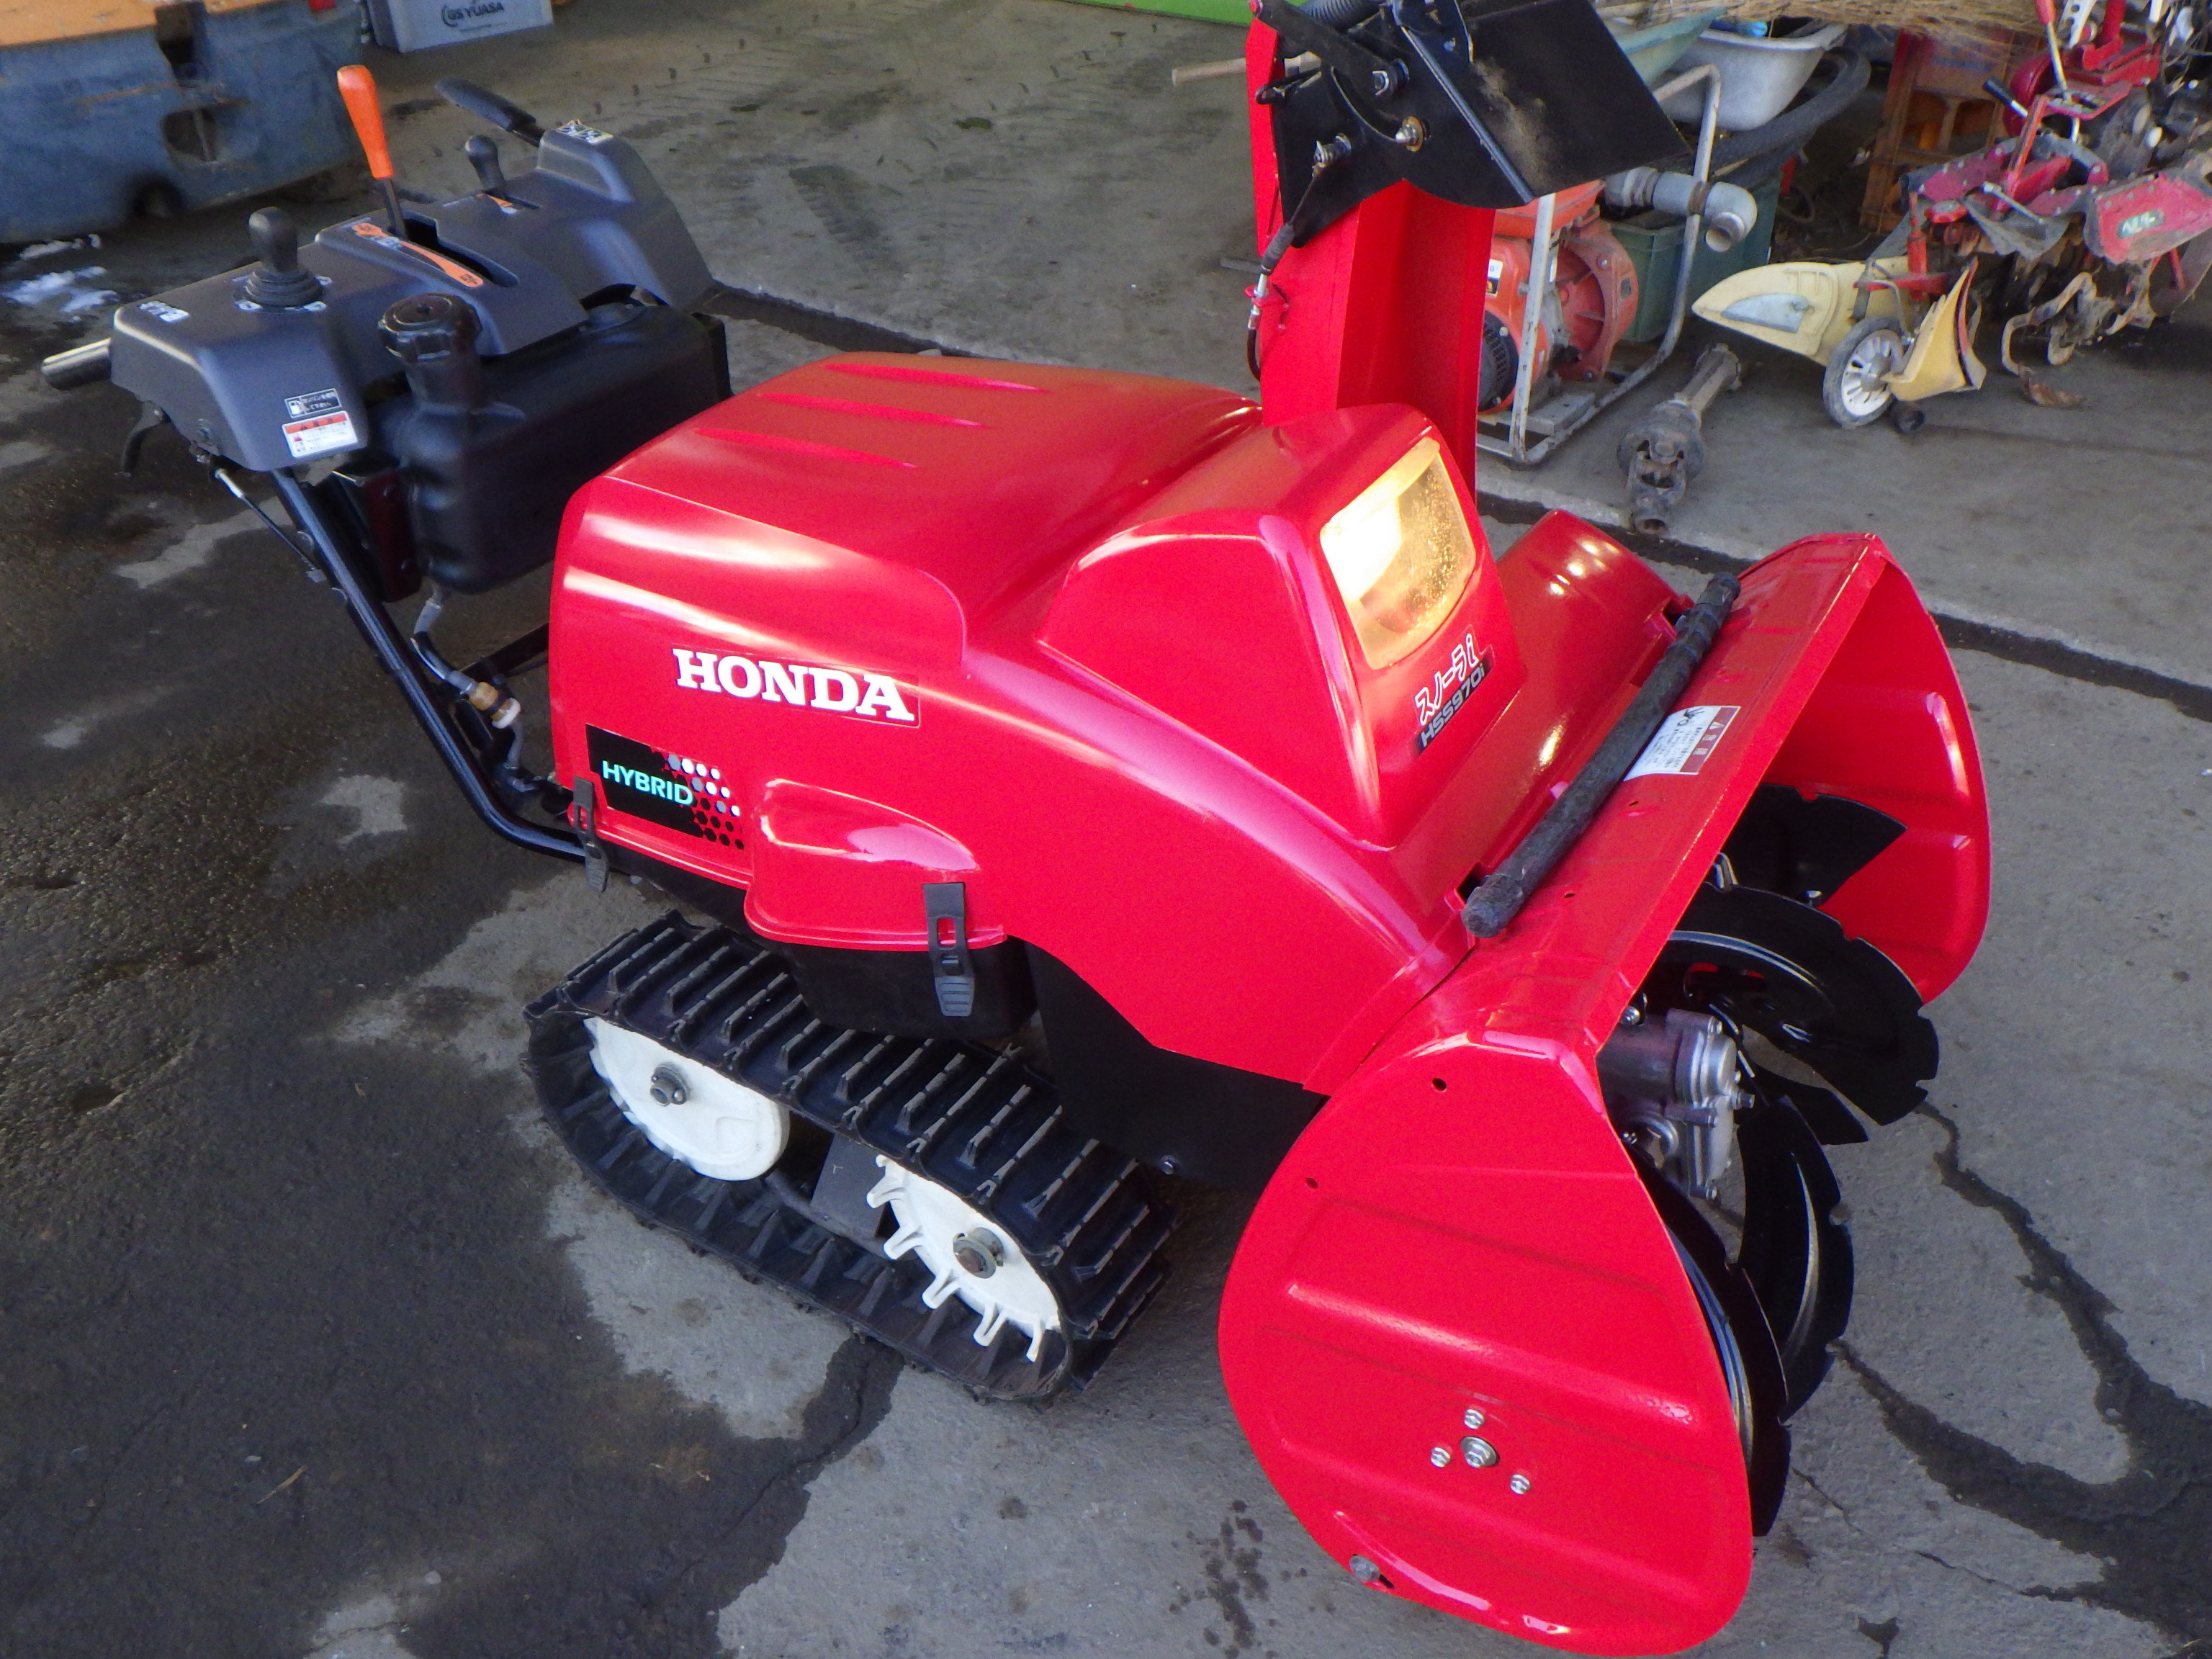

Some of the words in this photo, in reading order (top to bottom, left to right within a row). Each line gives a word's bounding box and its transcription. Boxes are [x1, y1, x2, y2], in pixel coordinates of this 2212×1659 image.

[464, 2, 505, 17] YUASA
[673, 648, 914, 721] HONDA
[1421, 662, 1485, 747] HSS970i
[602, 760, 694, 806] HYBRID
